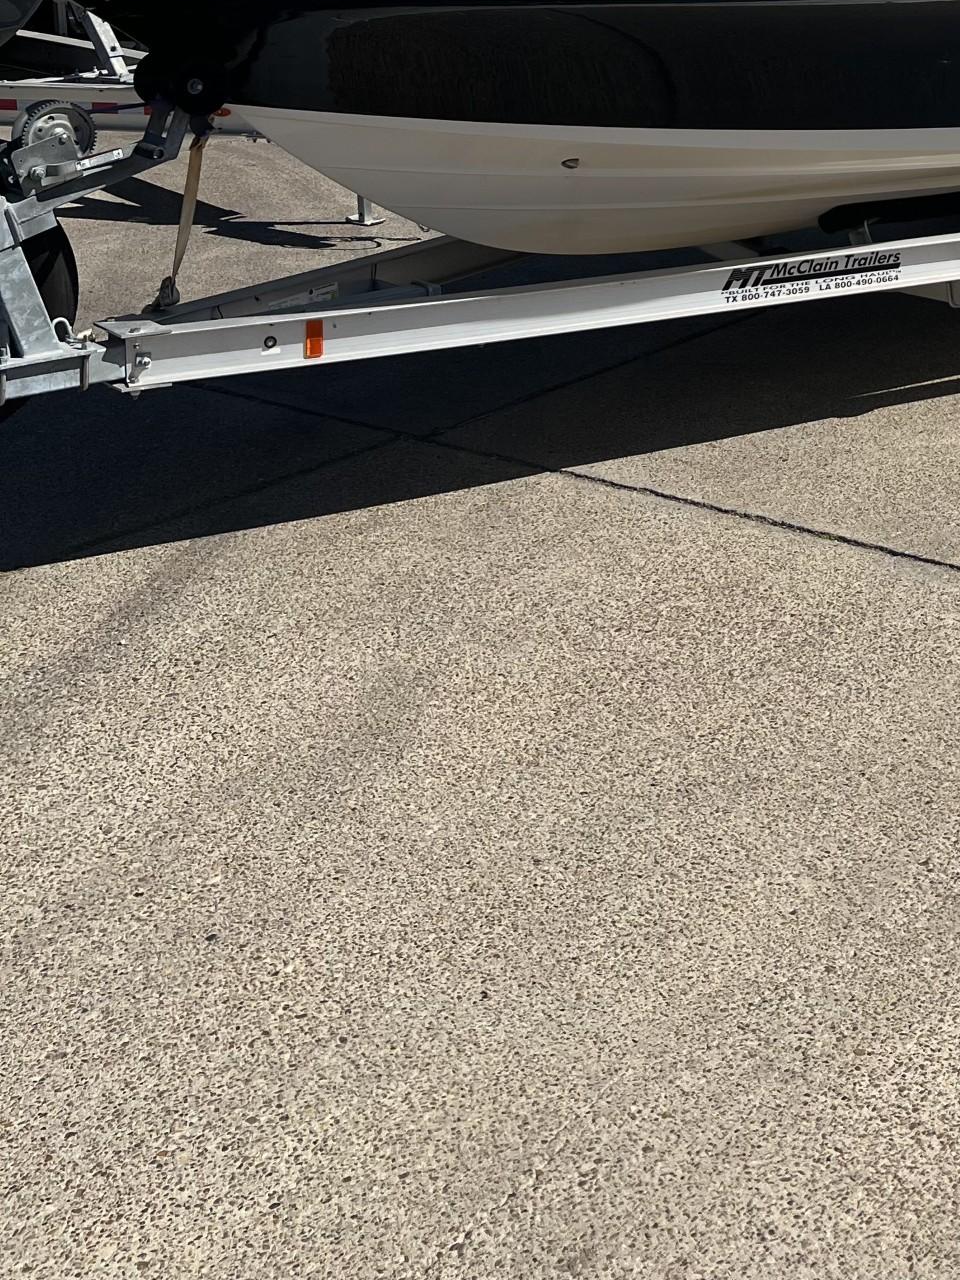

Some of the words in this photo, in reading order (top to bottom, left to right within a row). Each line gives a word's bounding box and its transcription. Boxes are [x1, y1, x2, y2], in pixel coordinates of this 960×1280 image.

[769, 257, 839, 278] McClain
[844, 251, 901, 269] Trailers
[725, 295, 738, 304] TX
[741, 286, 810, 302] 800-747-3059
[819, 283, 831, 291] LA
[835, 274, 899, 289] 800-490-0664
